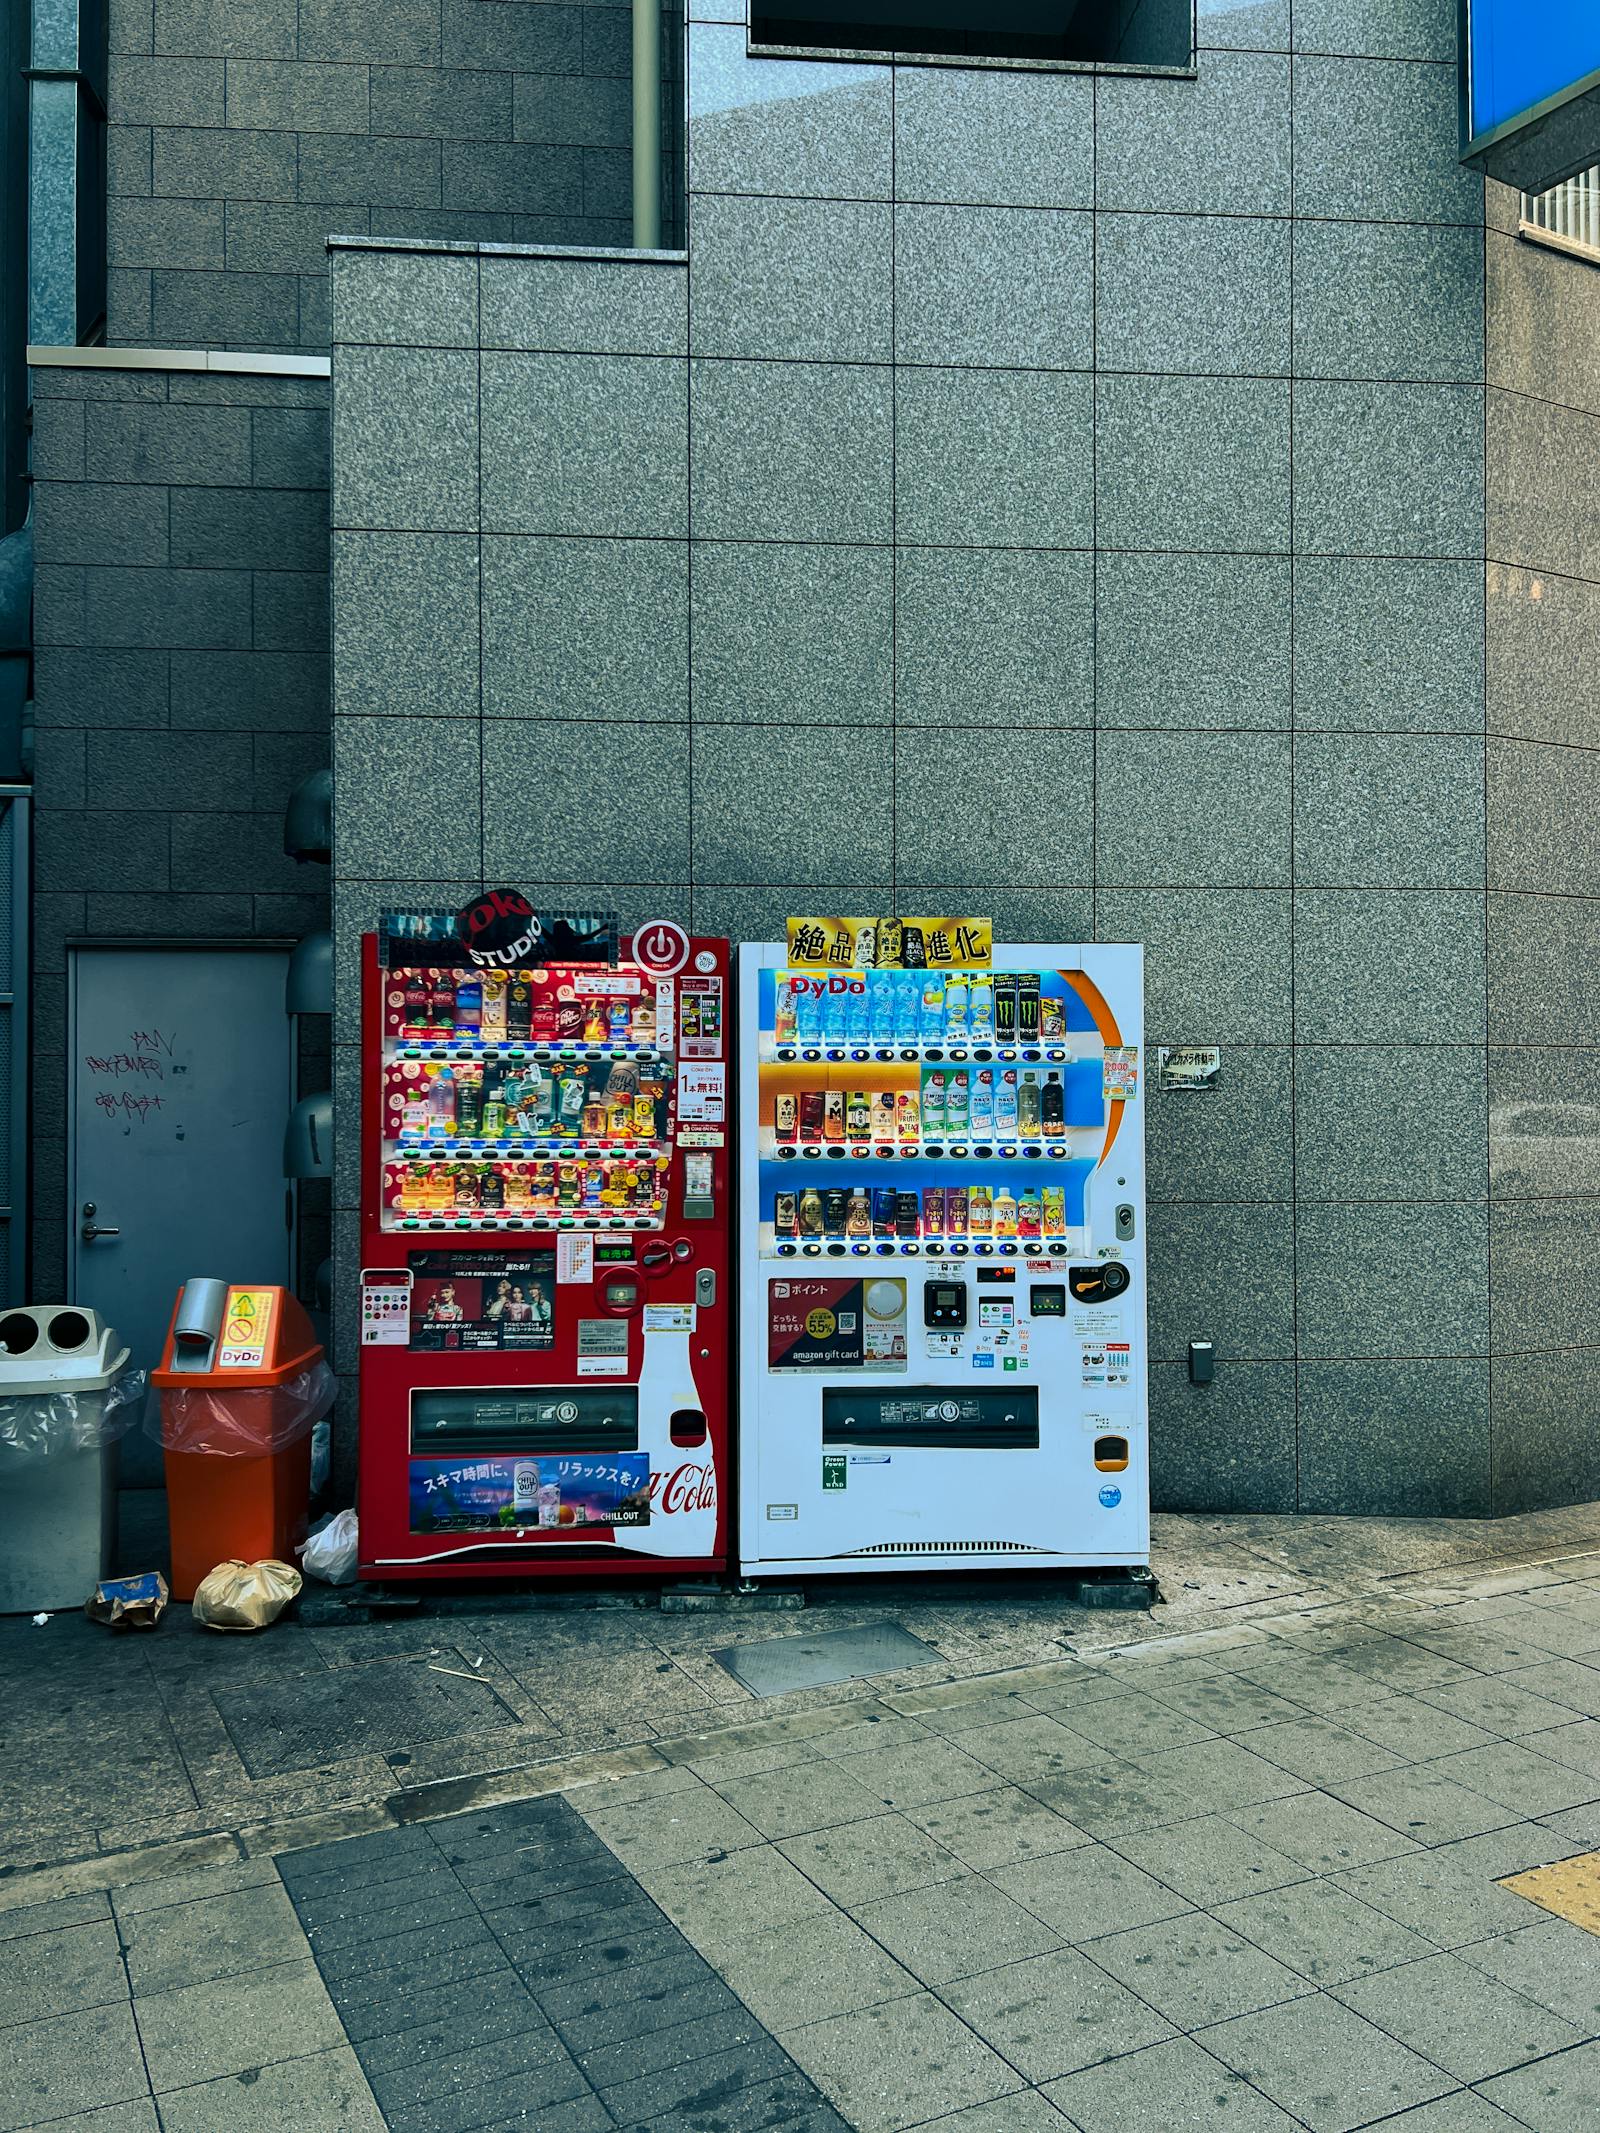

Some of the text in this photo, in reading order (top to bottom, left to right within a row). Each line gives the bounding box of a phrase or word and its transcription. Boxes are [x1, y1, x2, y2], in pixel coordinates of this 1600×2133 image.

[469, 916, 542, 967] STUDIO
[789, 923, 990, 962] 絶品 進化
[789, 977, 865, 998] DyDo
[609, 1082, 628, 1091] OUT
[601, 1249, 632, 1259] 販売中
[791, 1285, 829, 1295] ポイント
[773, 1315, 798, 1323] どっちと
[773, 1324, 804, 1333] 交換する?
[222, 1351, 260, 1364] DyDo
[793, 1350, 860, 1361] amazon gift card
[423, 1461, 640, 1493] スキマ時間に、 リラックスを!
[518, 1477, 537, 1486] CHILL
[519, 1483, 535, 1492] OUT
[600, 1511, 639, 1521] CHILL OUT
